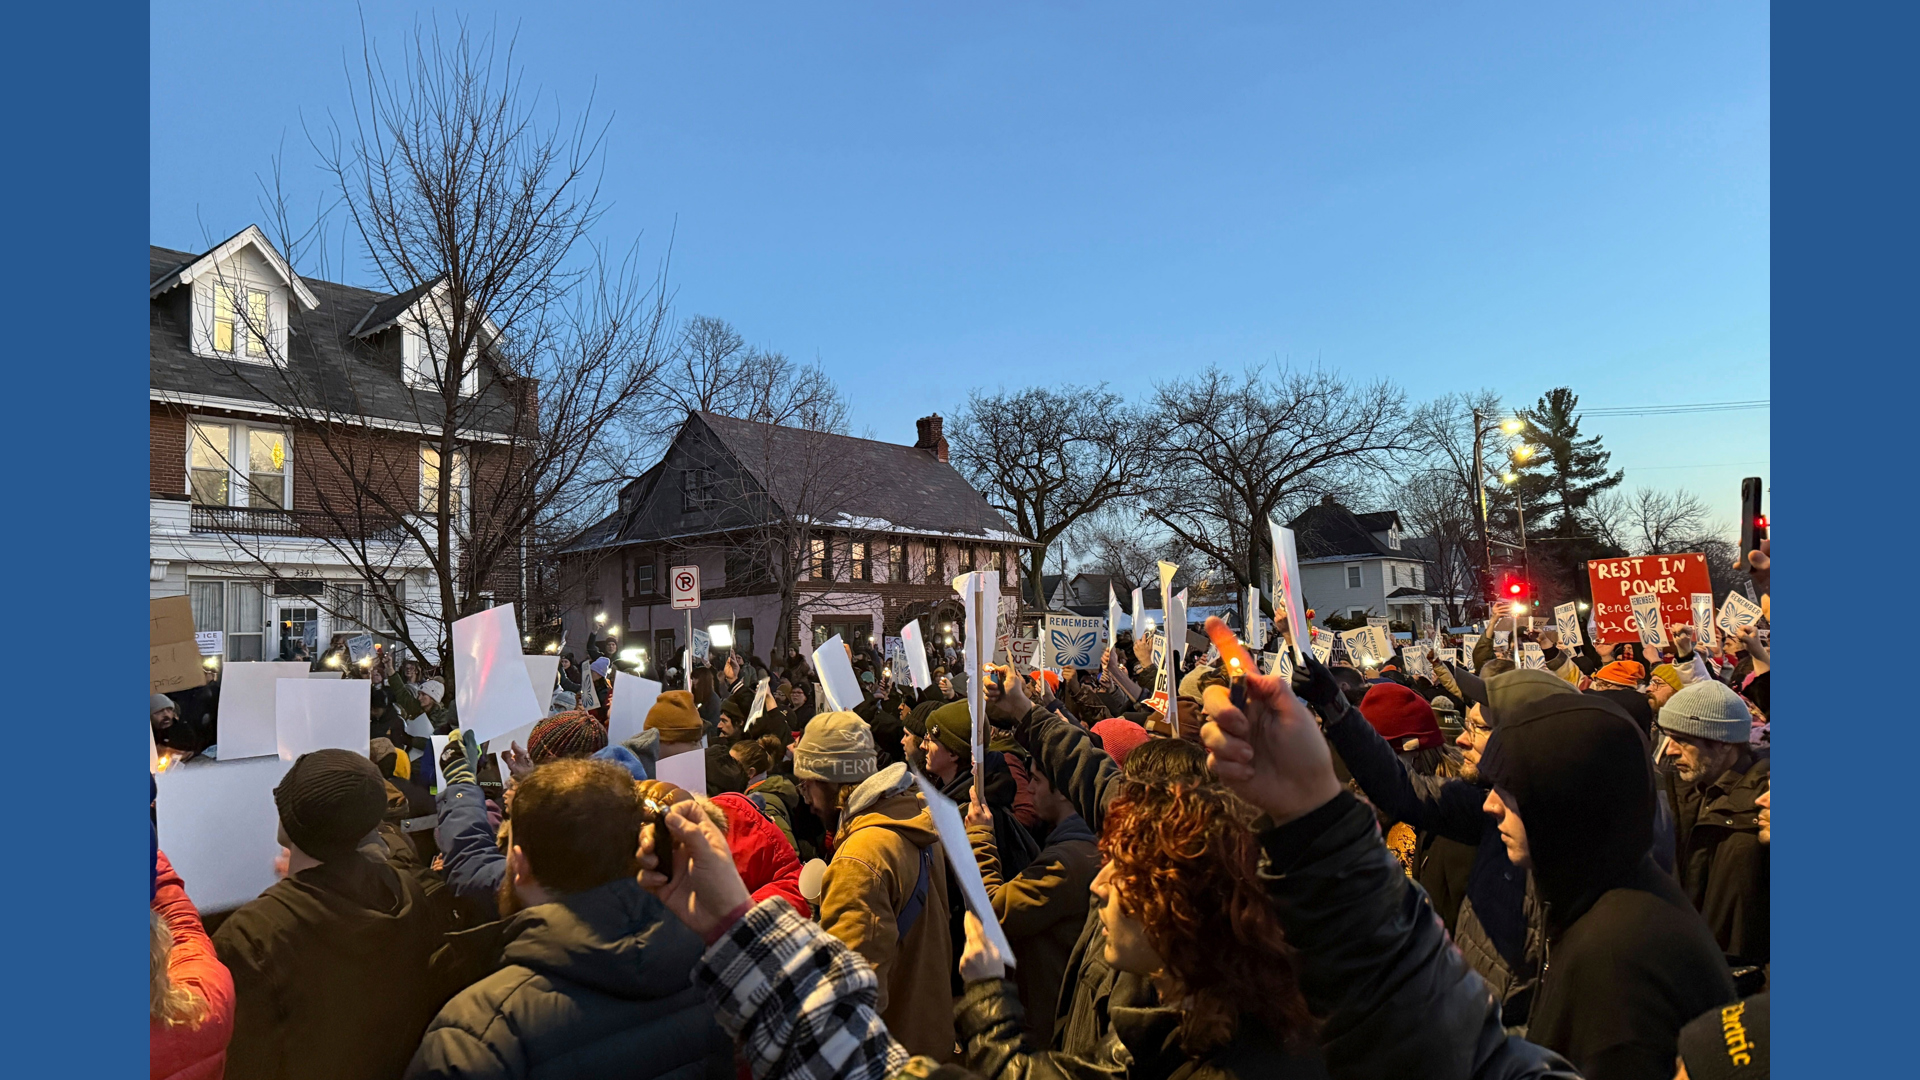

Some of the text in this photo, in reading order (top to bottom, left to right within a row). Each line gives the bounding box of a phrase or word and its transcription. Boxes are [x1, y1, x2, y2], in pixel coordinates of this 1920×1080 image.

[1598, 557, 1686, 580] REST IN
[1620, 577, 1680, 596] POWER
[1597, 602, 1632, 616] Rene
[1731, 593, 1762, 616] REMEMBER
[1050, 616, 1100, 628] REMEMBER
[1005, 655, 1032, 665] OUT
